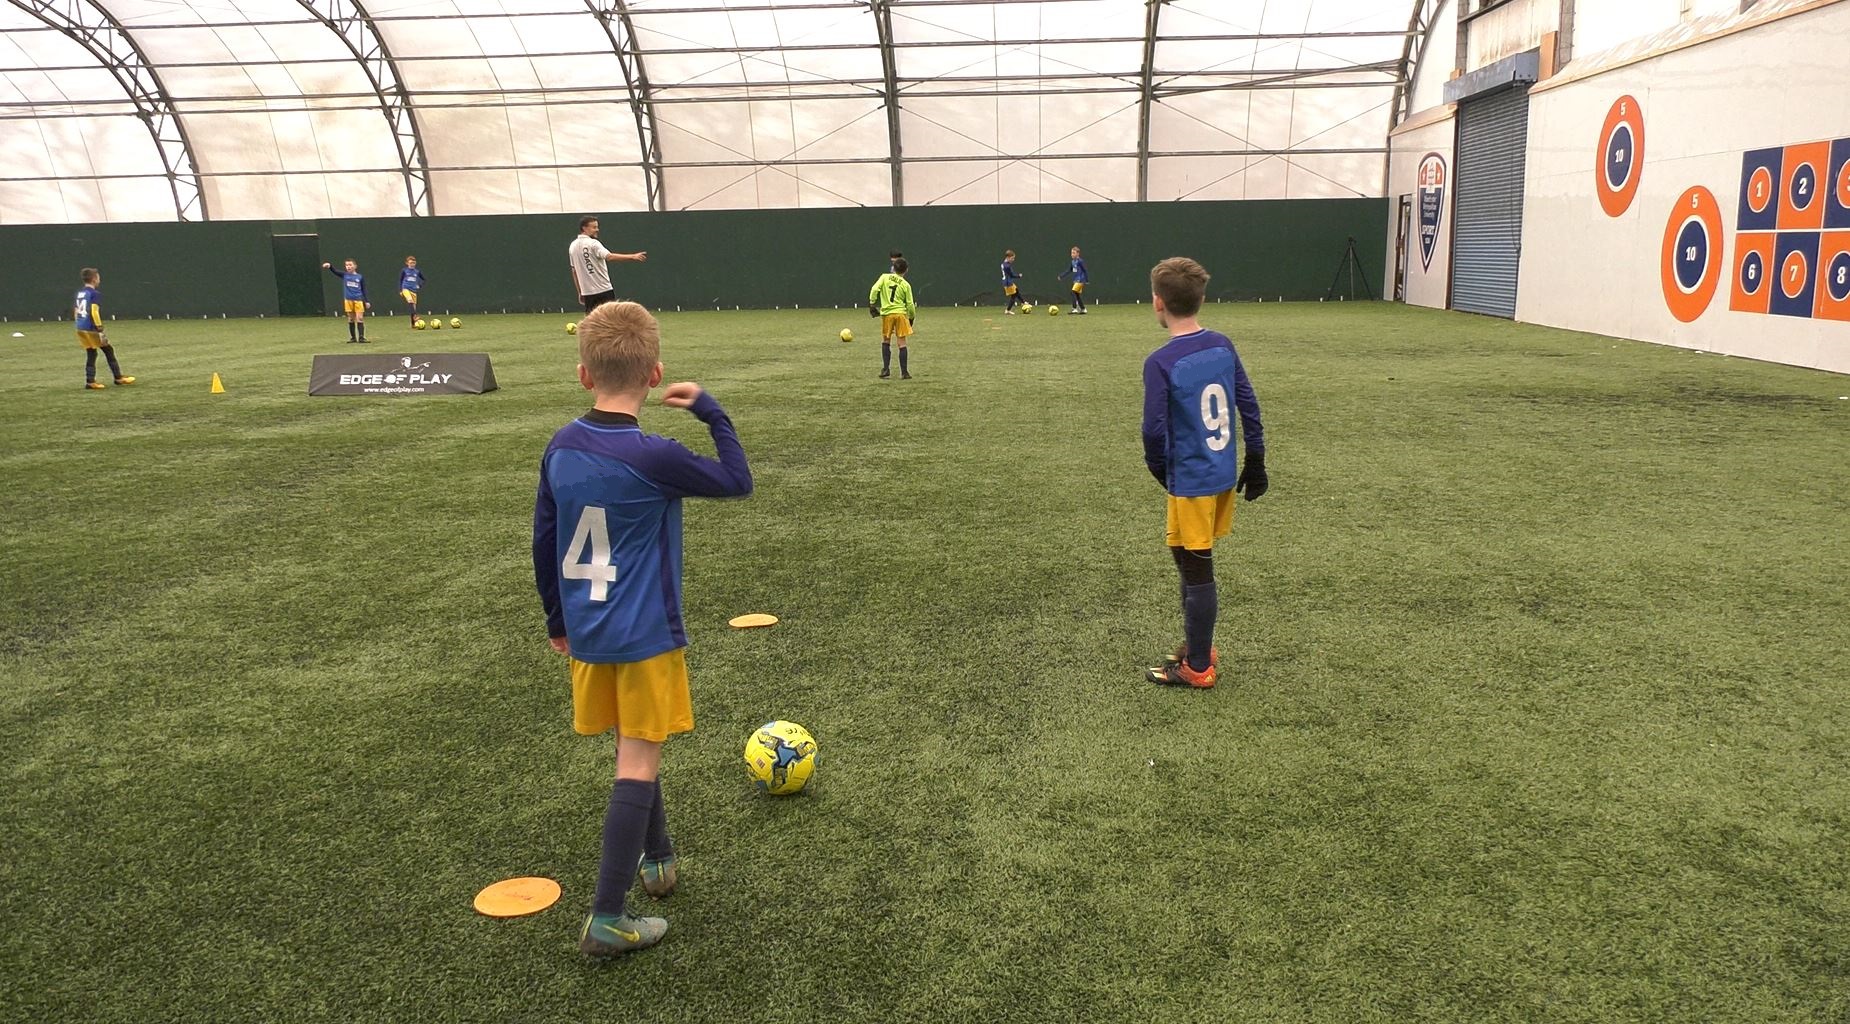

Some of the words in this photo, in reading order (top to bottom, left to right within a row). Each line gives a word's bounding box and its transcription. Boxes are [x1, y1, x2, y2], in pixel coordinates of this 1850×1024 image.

[1620, 102, 1626, 115] 5
[1615, 149, 1624, 162] 10
[1756, 181, 1763, 197] 1
[1798, 178, 1807, 195] 2
[1691, 193, 1699, 208] 5
[583, 247, 594, 274] COACH
[1685, 246, 1696, 261] 10
[1748, 264, 1756, 280] 6
[1790, 265, 1798, 282] 7
[1837, 266, 1846, 284] 8
[339, 374, 383, 385] EDGE
[409, 373, 453, 385] PLAY
[364, 386, 425, 394] www.edgeofplay.com
[1200, 383, 1230, 451] 9
[562, 505, 617, 602] 4
